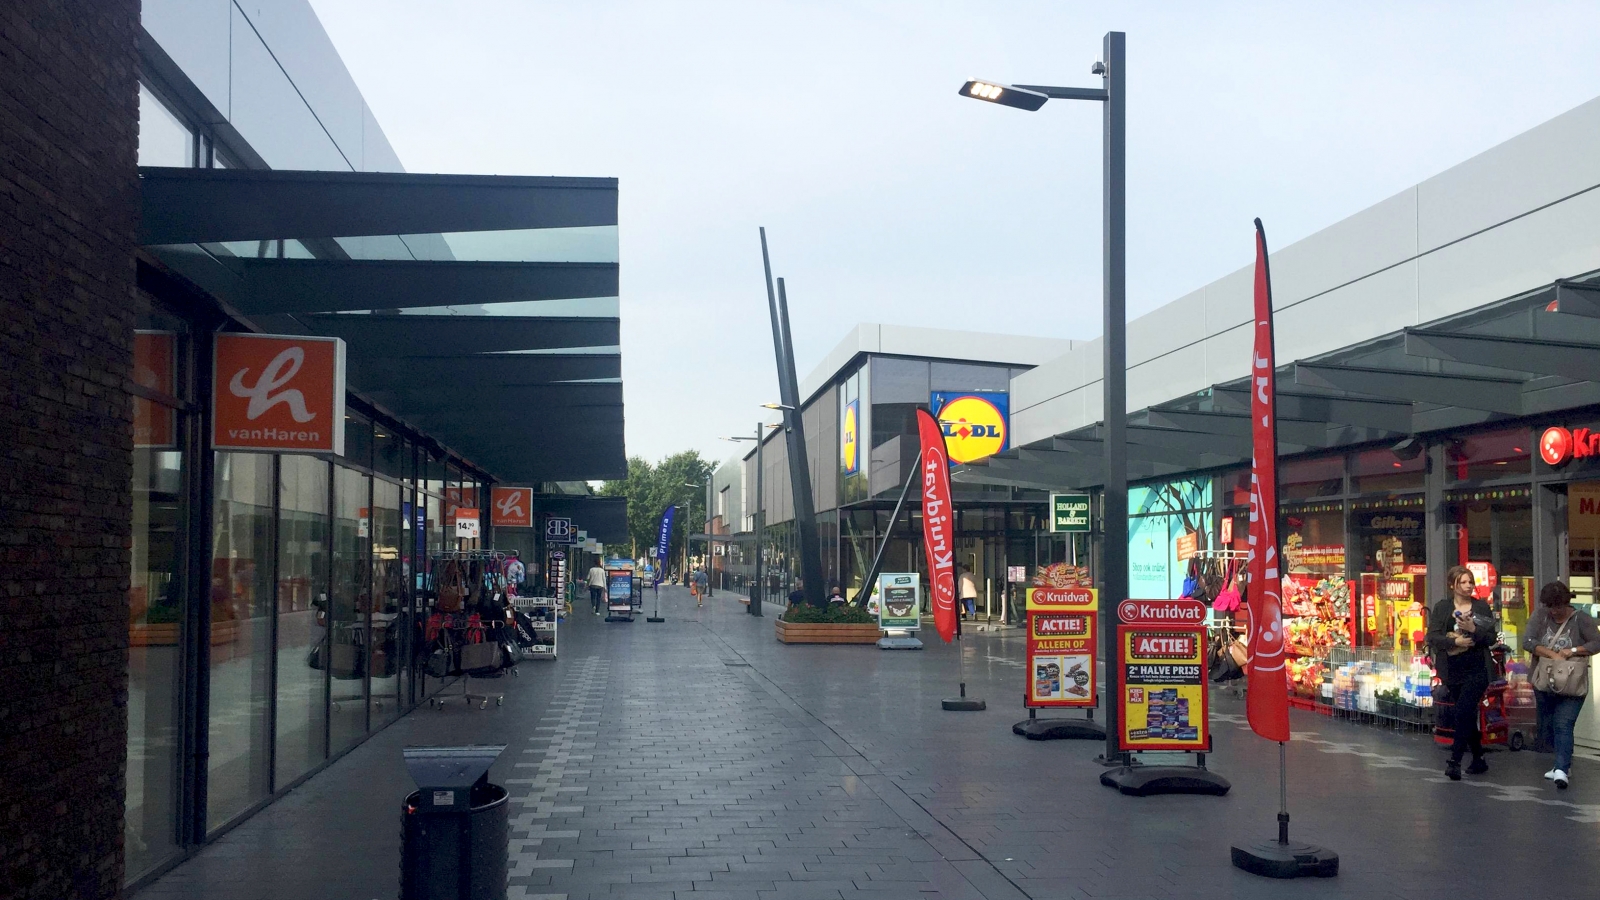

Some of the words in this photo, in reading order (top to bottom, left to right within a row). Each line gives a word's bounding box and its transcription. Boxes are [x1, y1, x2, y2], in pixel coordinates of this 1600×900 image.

[228, 427, 320, 441] vanHaren
[1574, 427, 1600, 458] Kr
[1056, 503, 1088, 511] HOLLAND
[1069, 510, 1077, 518] &
[1057, 517, 1088, 525] BARRETT
[1371, 516, 1419, 528] Gillette
[659, 518, 669, 554] Primera
[1133, 562, 1143, 573] Shop
[1143, 563, 1151, 572] ook
[1047, 592, 1089, 602] Kruidvat
[1140, 604, 1200, 619] Kruidvat
[1042, 619, 1081, 631] ACTIE!
[1037, 641, 1071, 650] ALLEEN
[1073, 640, 1085, 649] OP
[1139, 638, 1189, 653] ACTIE!
[1140, 666, 1170, 675] HALVE
[1172, 666, 1200, 675] PRIJS
